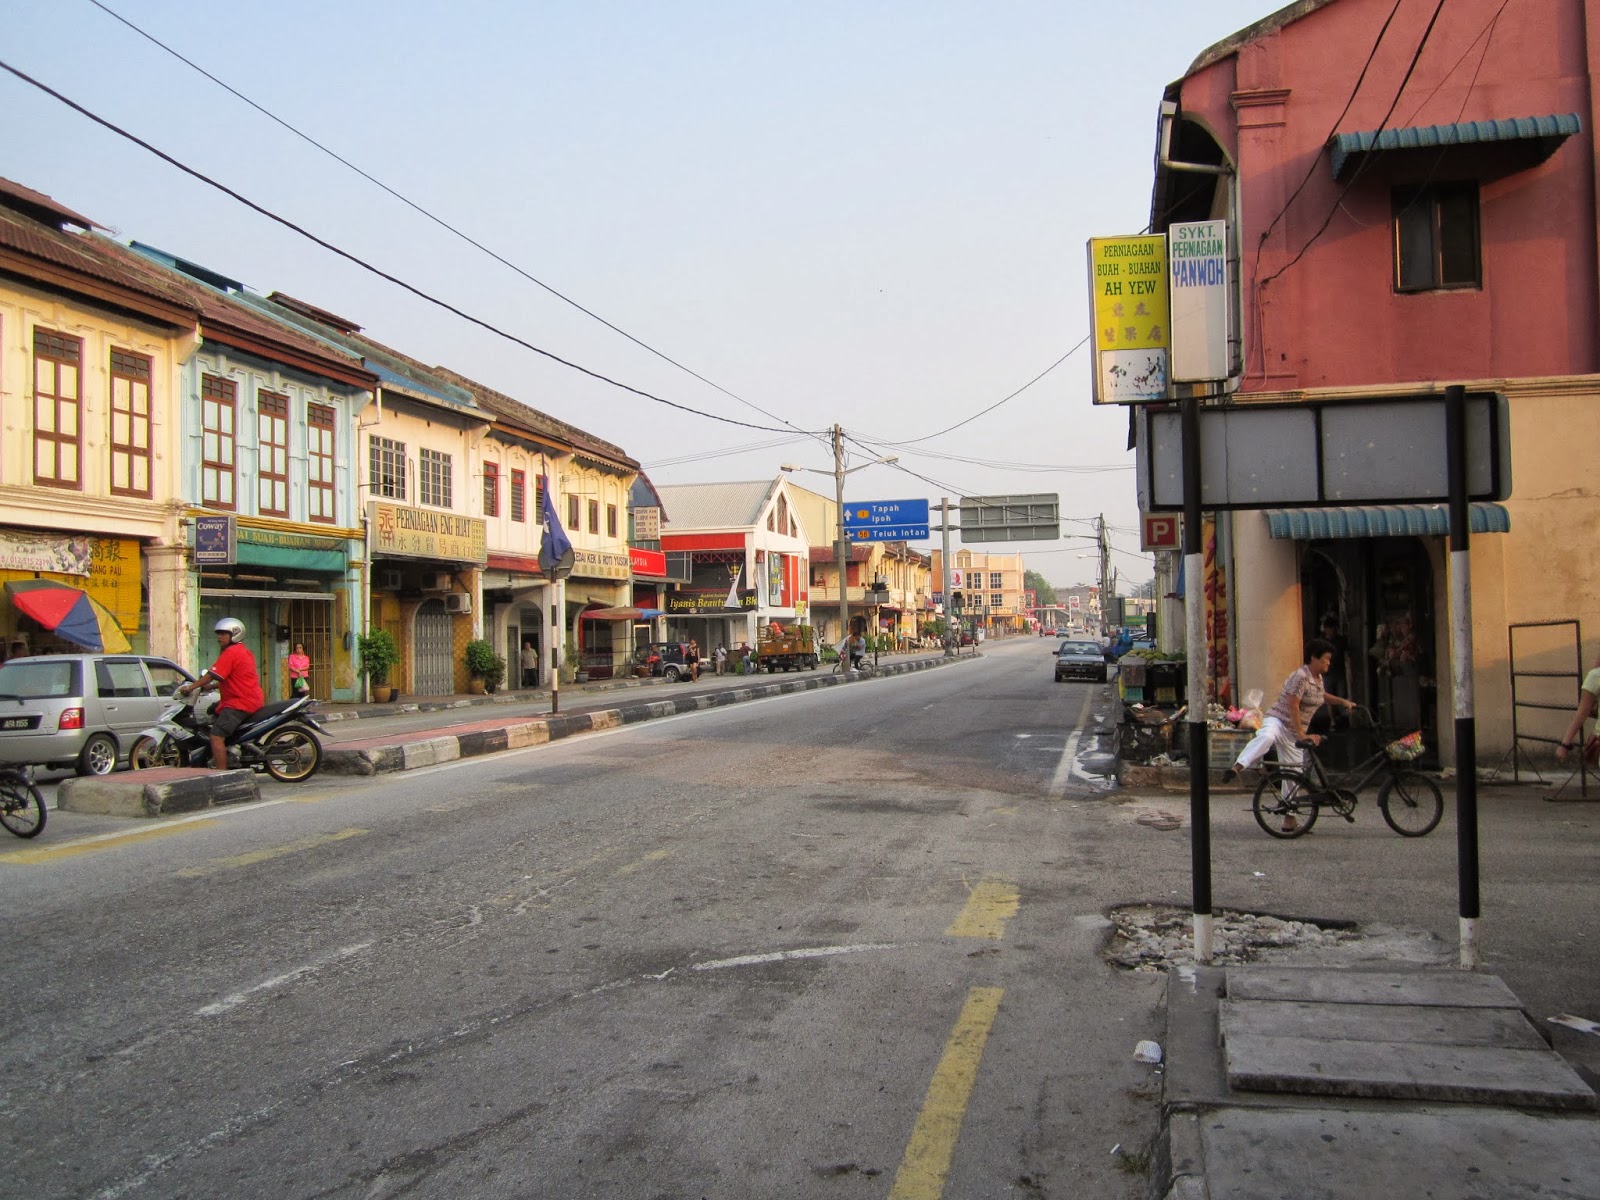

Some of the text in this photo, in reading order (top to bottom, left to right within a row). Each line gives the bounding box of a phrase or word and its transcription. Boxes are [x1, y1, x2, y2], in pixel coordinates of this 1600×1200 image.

[1179, 225, 1216, 239] SYKT.
[1104, 243, 1154, 257] PERNIAGAAN
[1173, 240, 1223, 258] PERNIAGAAN
[1097, 263, 1119, 276] BUAH
[1129, 261, 1161, 274] BUAHAN
[1173, 258, 1224, 288] YANWOH
[1105, 280, 1157, 296] AH YEW
[872, 504, 900, 513] Tapah
[396, 508, 438, 533] PERNIAGAAN
[440, 515, 453, 535] ENG
[455, 519, 471, 538] HUAT
[872, 514, 891, 523] Ipoh
[197, 522, 225, 531] Coway
[873, 529, 897, 537] Teluk
[901, 528, 926, 537] Intan
[1152, 521, 1169, 542] P
[587, 553, 596, 564] KEK
[92, 565, 122, 576] IANG PAU
[697, 598, 726, 610] Beauty
